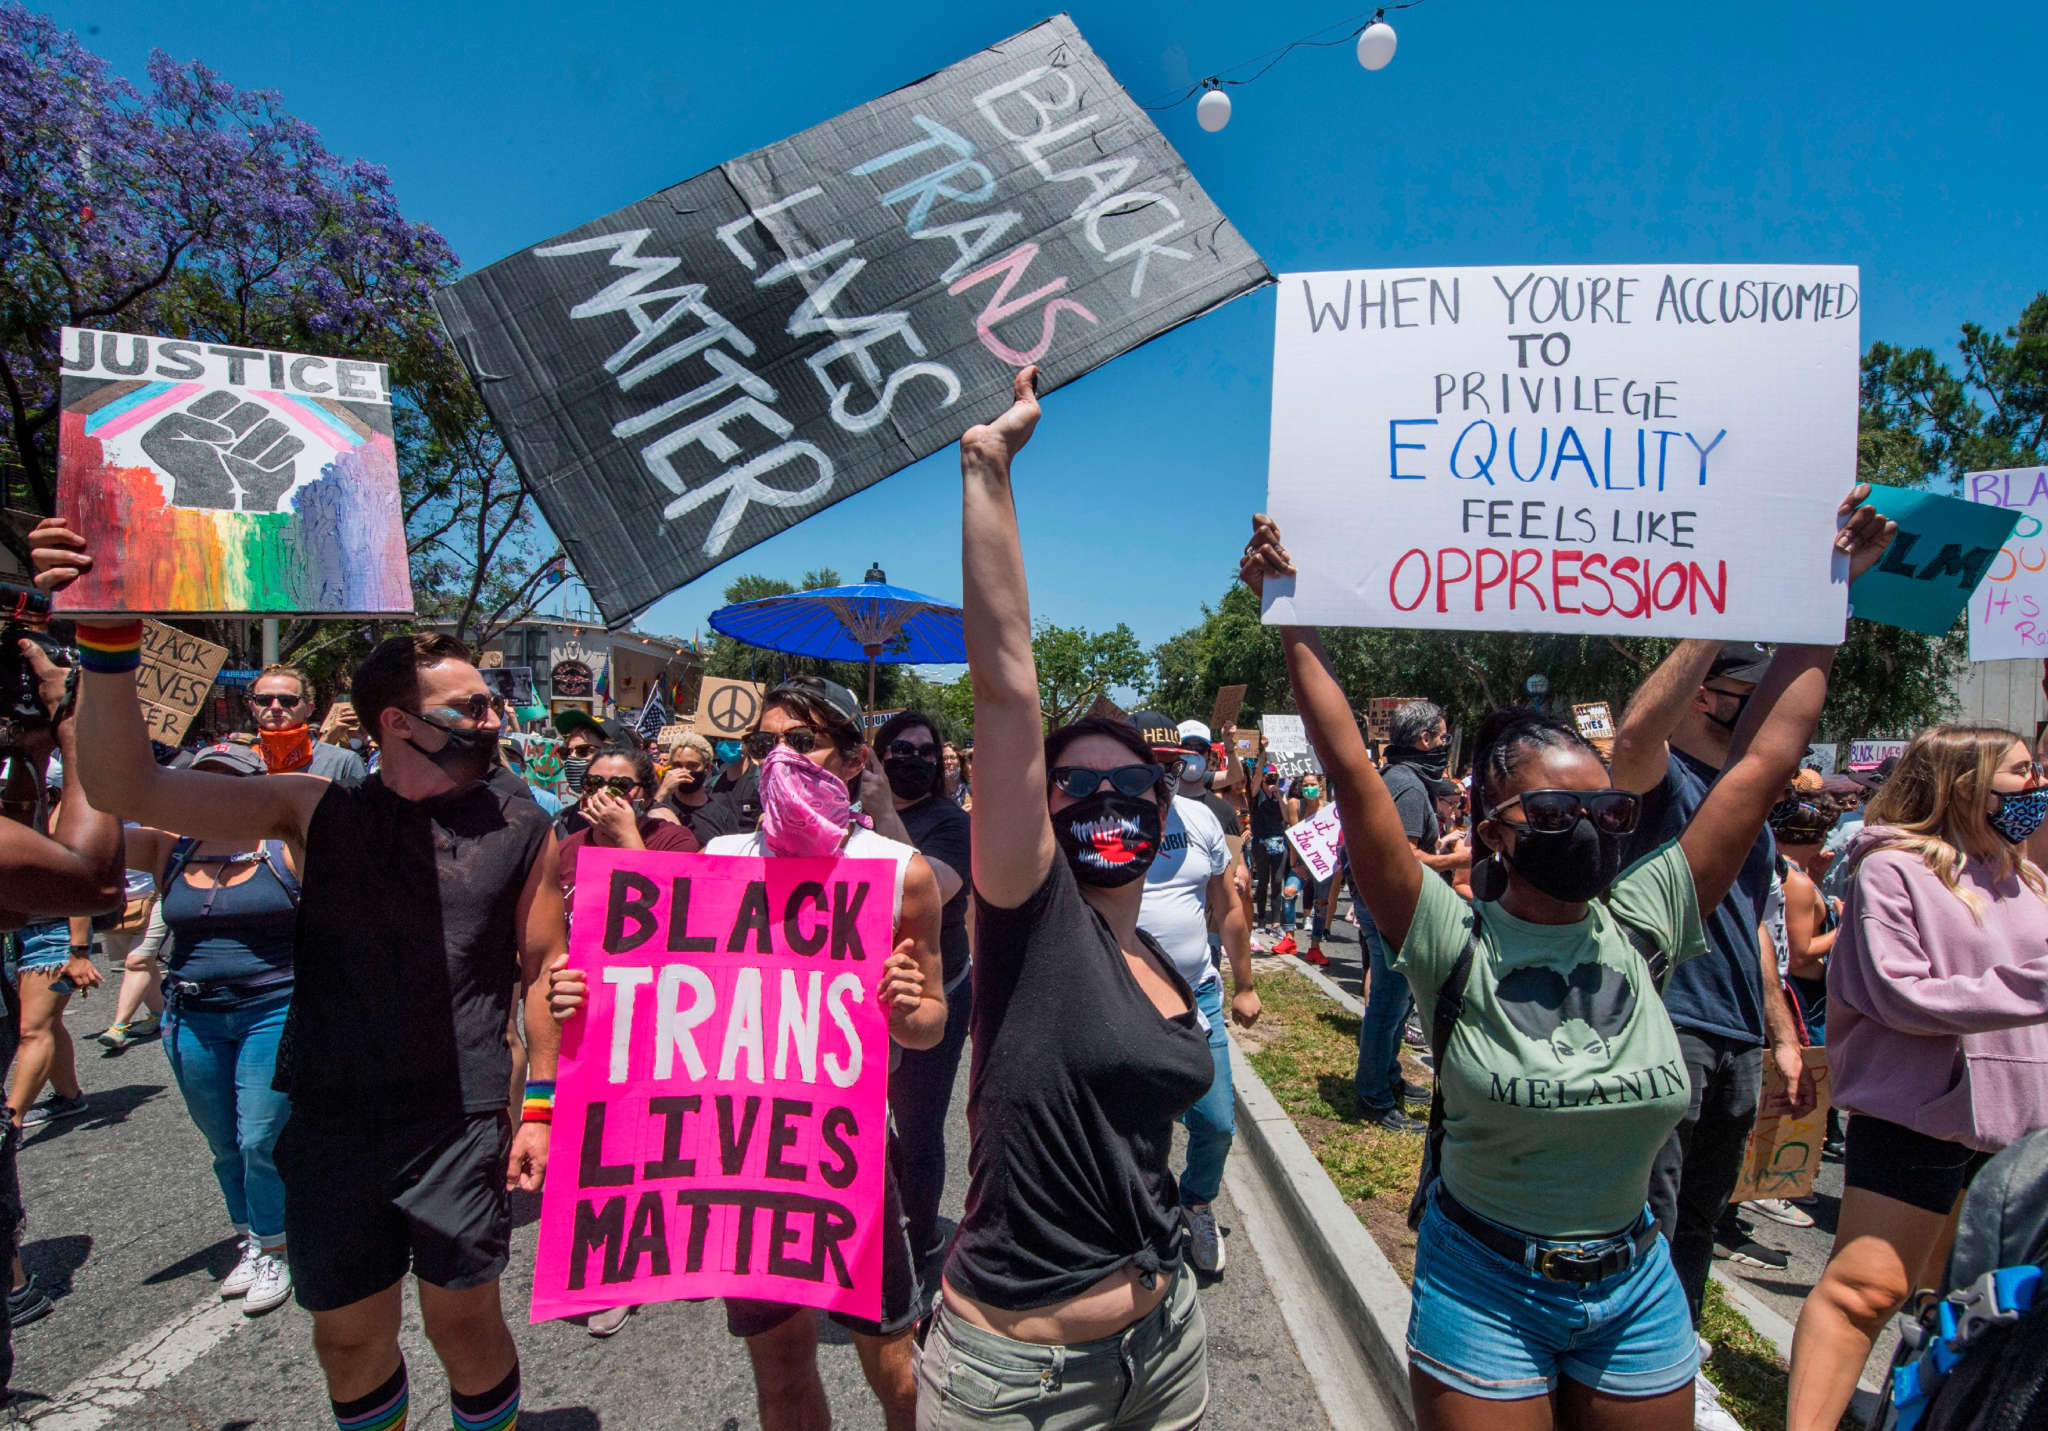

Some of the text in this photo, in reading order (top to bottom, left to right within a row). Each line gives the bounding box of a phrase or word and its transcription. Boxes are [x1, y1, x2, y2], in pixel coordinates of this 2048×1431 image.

[972, 66, 1194, 299] BLACK
[851, 114, 1099, 367] TRANS
[715, 187, 963, 434] LIVES
[1302, 277, 1460, 333] WHEN
[1655, 274, 1859, 323] ACCUSTOMED
[1508, 332, 1572, 369] TO
[532, 228, 835, 558] MATTER
[1434, 371, 1680, 422] PRIVILEGE
[1389, 418, 1728, 492] EQUALITY
[1462, 498, 1698, 548] FEELS LIKE
[1388, 547, 1727, 620] OPPRESSION
[1878, 531, 2000, 589] LM
[136, 663, 207, 706] IVES
[1143, 728, 1181, 745] HELLO
[1850, 744, 1874, 762] BLACK
[1293, 830, 1315, 851] the
[602, 868, 870, 961] BLACK
[601, 964, 865, 1089] TRANS
[1488, 1058, 1687, 1109] MELANIN
[577, 1094, 859, 1189] LIVES
[566, 1188, 857, 1291] MATTER
